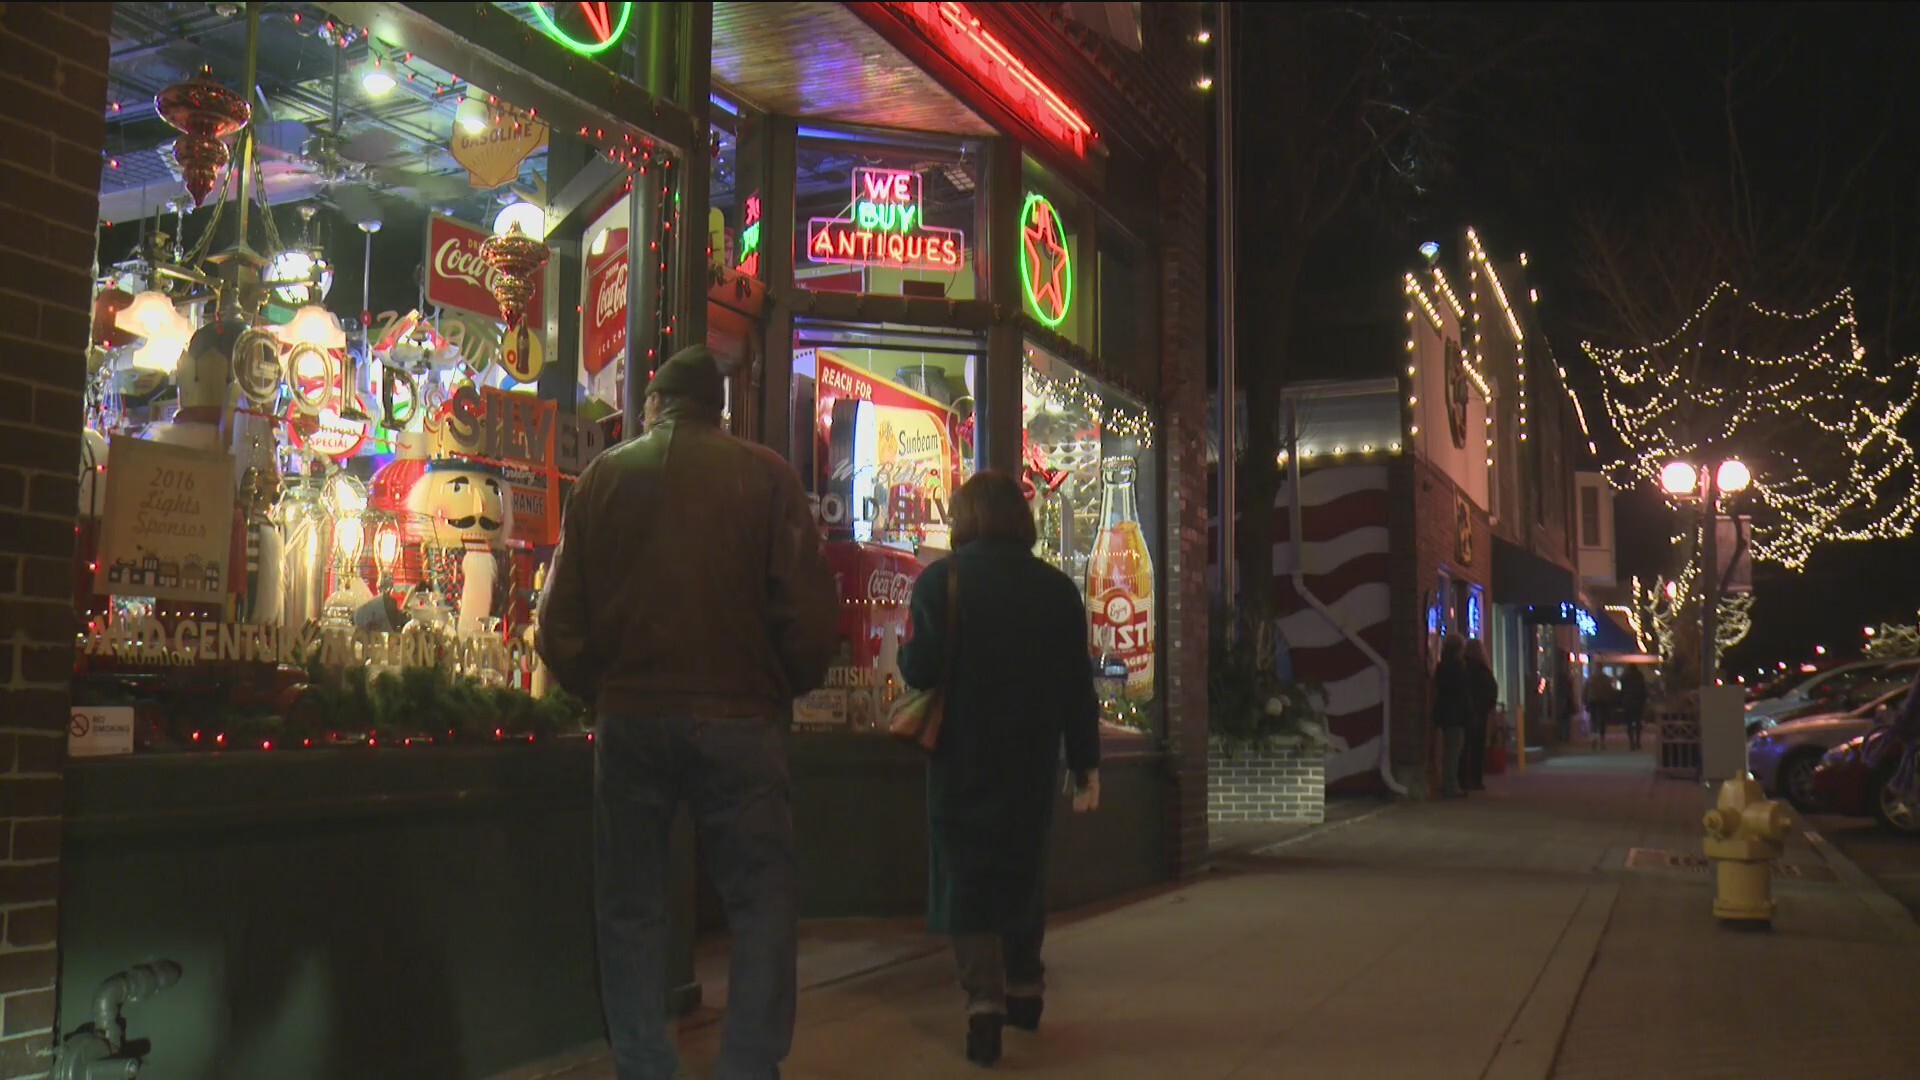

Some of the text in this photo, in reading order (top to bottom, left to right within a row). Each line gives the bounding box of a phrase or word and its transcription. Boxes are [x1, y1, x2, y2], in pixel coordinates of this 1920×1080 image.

[864, 172, 912, 200] WE
[858, 202, 916, 233] BUY
[811, 230, 957, 265] ANTIQUES
[822, 366, 873, 400] REACH FOR
[310, 438, 348, 448] SPECIAL
[899, 430, 938, 456] Sunbeam
[150, 467, 195, 491] 2016
[140, 489, 200, 517] Lights
[512, 493, 545, 516] RANGE
[132, 511, 206, 538] Sponsor
[174, 619, 317, 664] CENTURY
